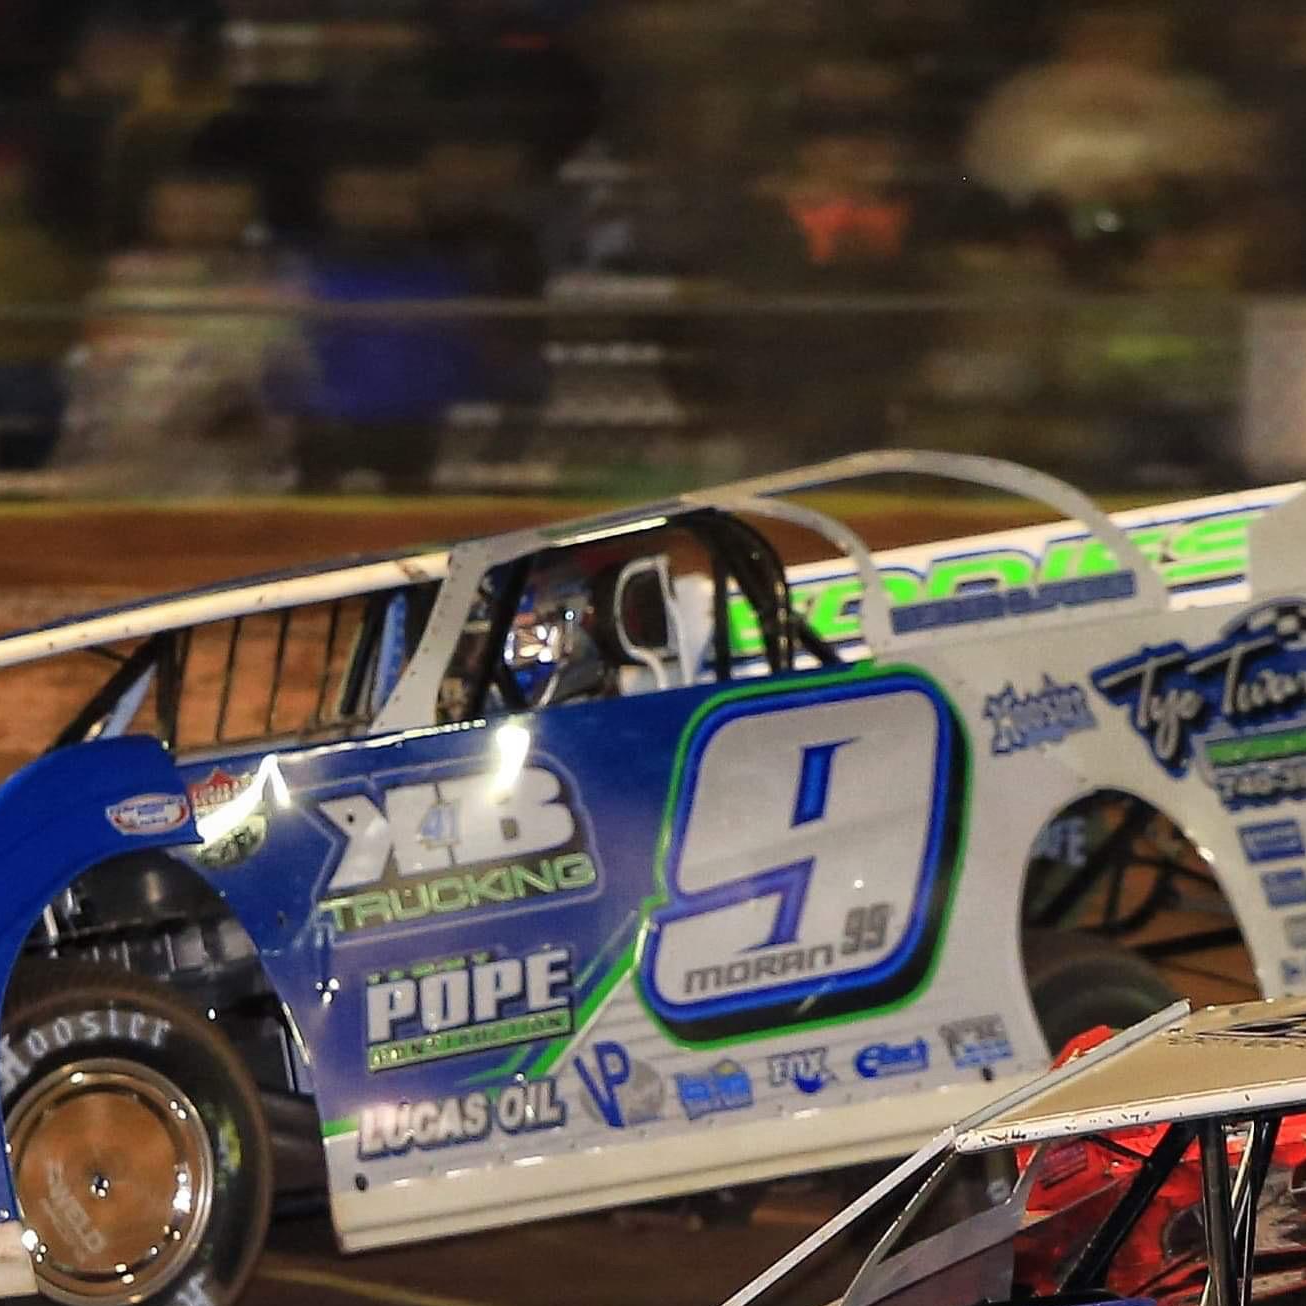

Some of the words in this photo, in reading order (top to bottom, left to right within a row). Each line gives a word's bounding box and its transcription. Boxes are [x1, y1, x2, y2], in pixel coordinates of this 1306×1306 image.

[651, 685, 945, 1010] 9
[319, 853, 596, 931] TRUCKING
[368, 950, 570, 1041] POPE
[359, 1092, 489, 1159] LUCAS
[496, 1079, 566, 1134] OIL
[574, 1041, 631, 1129] VP
